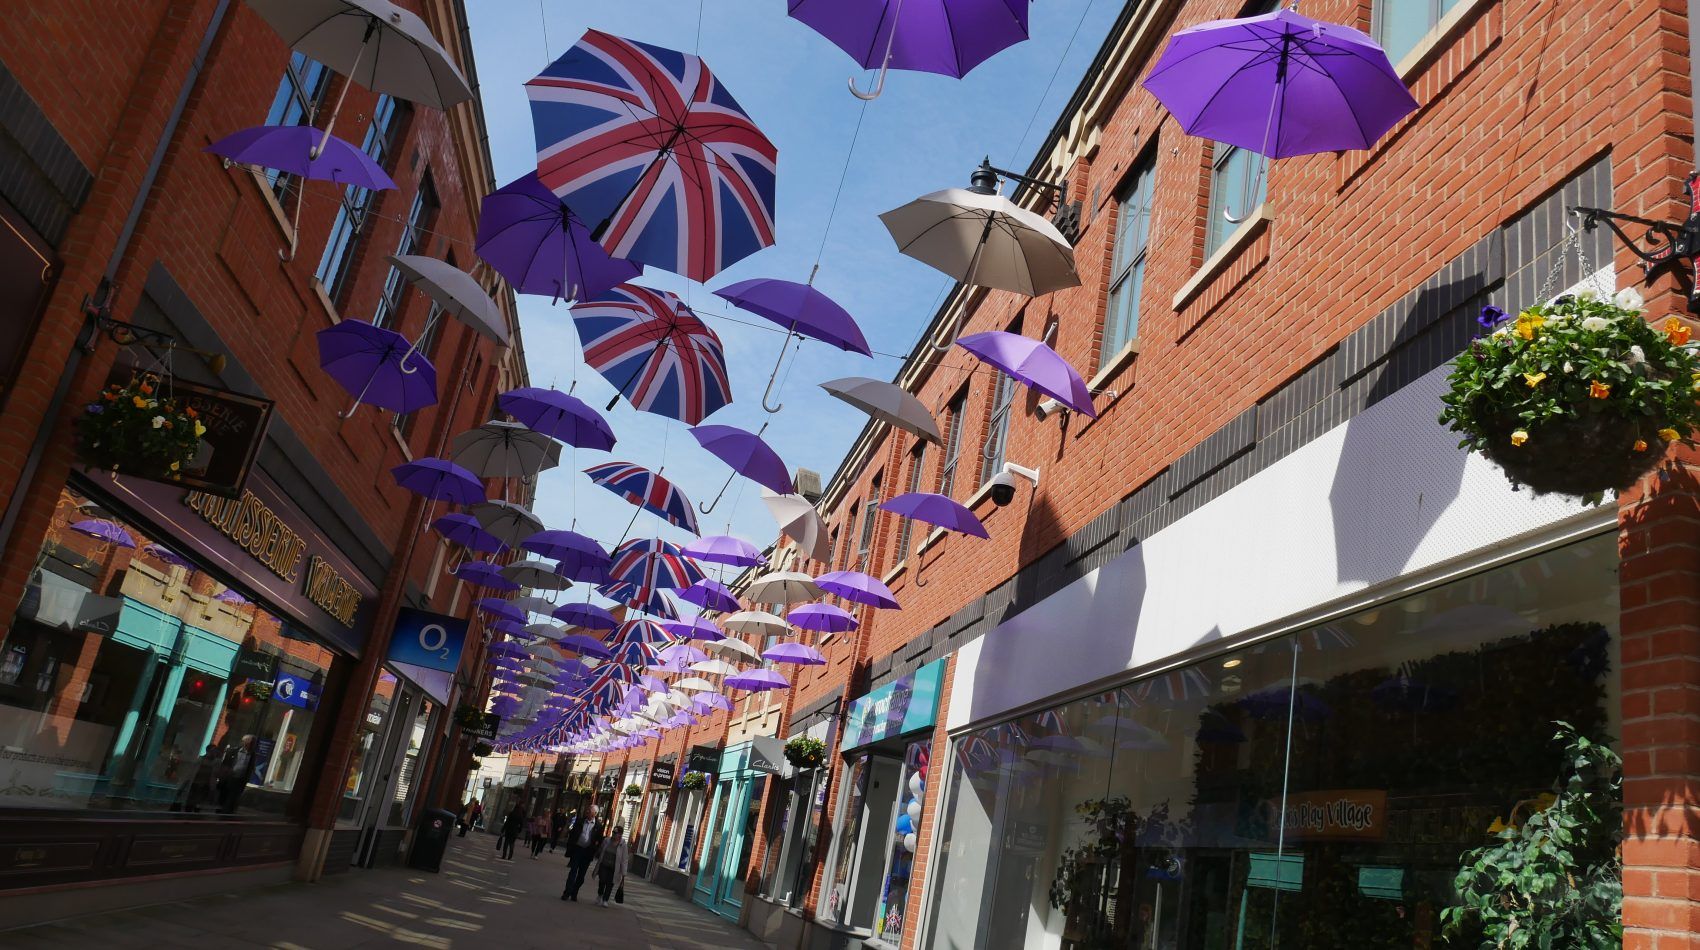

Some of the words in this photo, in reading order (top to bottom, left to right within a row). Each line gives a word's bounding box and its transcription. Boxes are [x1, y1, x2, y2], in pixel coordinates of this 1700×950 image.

[753, 759, 780, 771] Clarks
[1300, 800, 1324, 832] Play
[1326, 799, 1374, 831] Village
